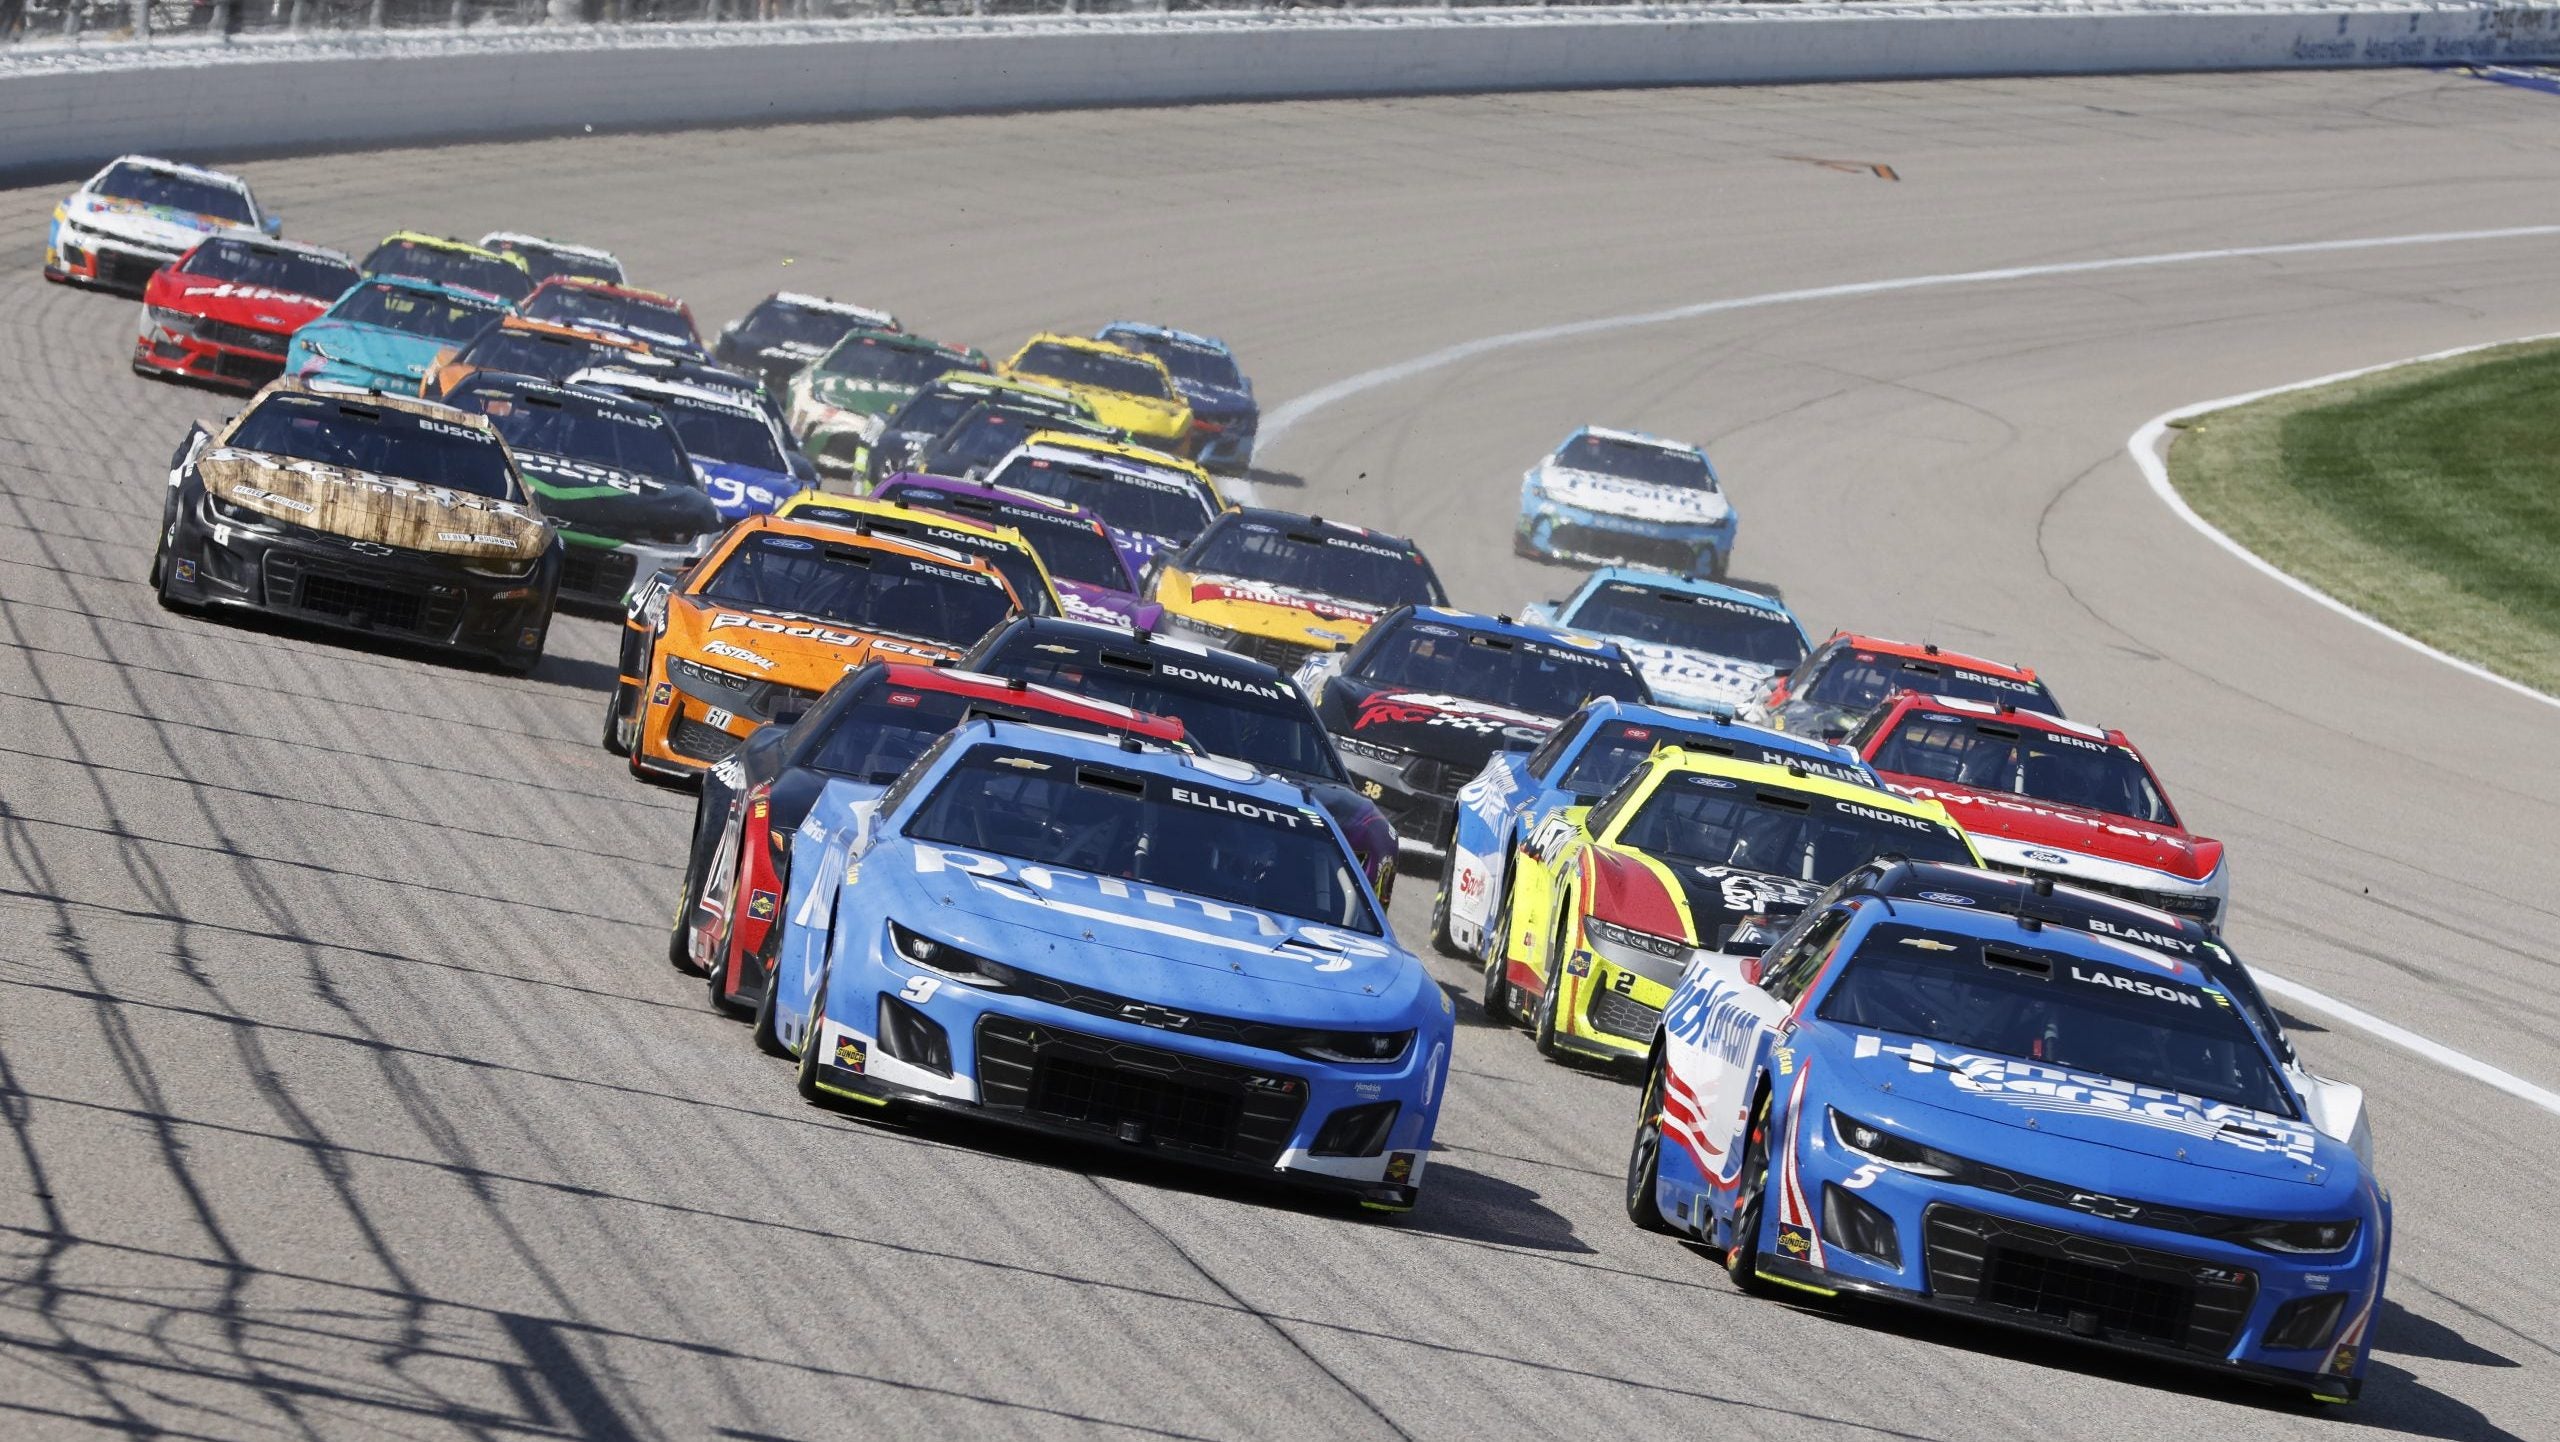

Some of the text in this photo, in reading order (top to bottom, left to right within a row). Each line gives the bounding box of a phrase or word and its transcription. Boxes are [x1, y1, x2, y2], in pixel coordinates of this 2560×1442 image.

[419, 419, 494, 445] BUSCH
[597, 409, 661, 430] HALEY
[1113, 473, 1183, 495] REDDICK
[1000, 505, 1094, 532] KESELOWSK
[927, 528, 1008, 553] LOGANO
[1326, 538, 1402, 560] GRAGSON
[909, 561, 988, 587] PREECE
[1220, 586, 1309, 610] TRUCK
[1696, 596, 1790, 624] CHASTAIN
[702, 639, 777, 671] FASTENAL
[1548, 649, 1609, 669] SMITH
[1162, 664, 1279, 700] BOWMAN
[1955, 670, 2039, 695] BRISCOE
[703, 704, 733, 731] 60
[2048, 733, 2108, 753] BERRY
[1762, 751, 1864, 783] HAMLIN
[1360, 781, 1384, 800] 38
[1171, 787, 1301, 828] ELLIOTT
[1836, 802, 1932, 833] CINDRIC
[1886, 782, 2193, 856] Motorcraft
[914, 843, 1390, 972] prime
[2088, 918, 2197, 954] BLANEY
[899, 975, 943, 1004] 9
[1614, 971, 1637, 995] 2
[2070, 966, 2203, 1009] LARSON
[837, 1048, 866, 1063] SUNOCO
[1841, 1164, 1888, 1189] 5
[1779, 1235, 1810, 1250] SUNOCO
